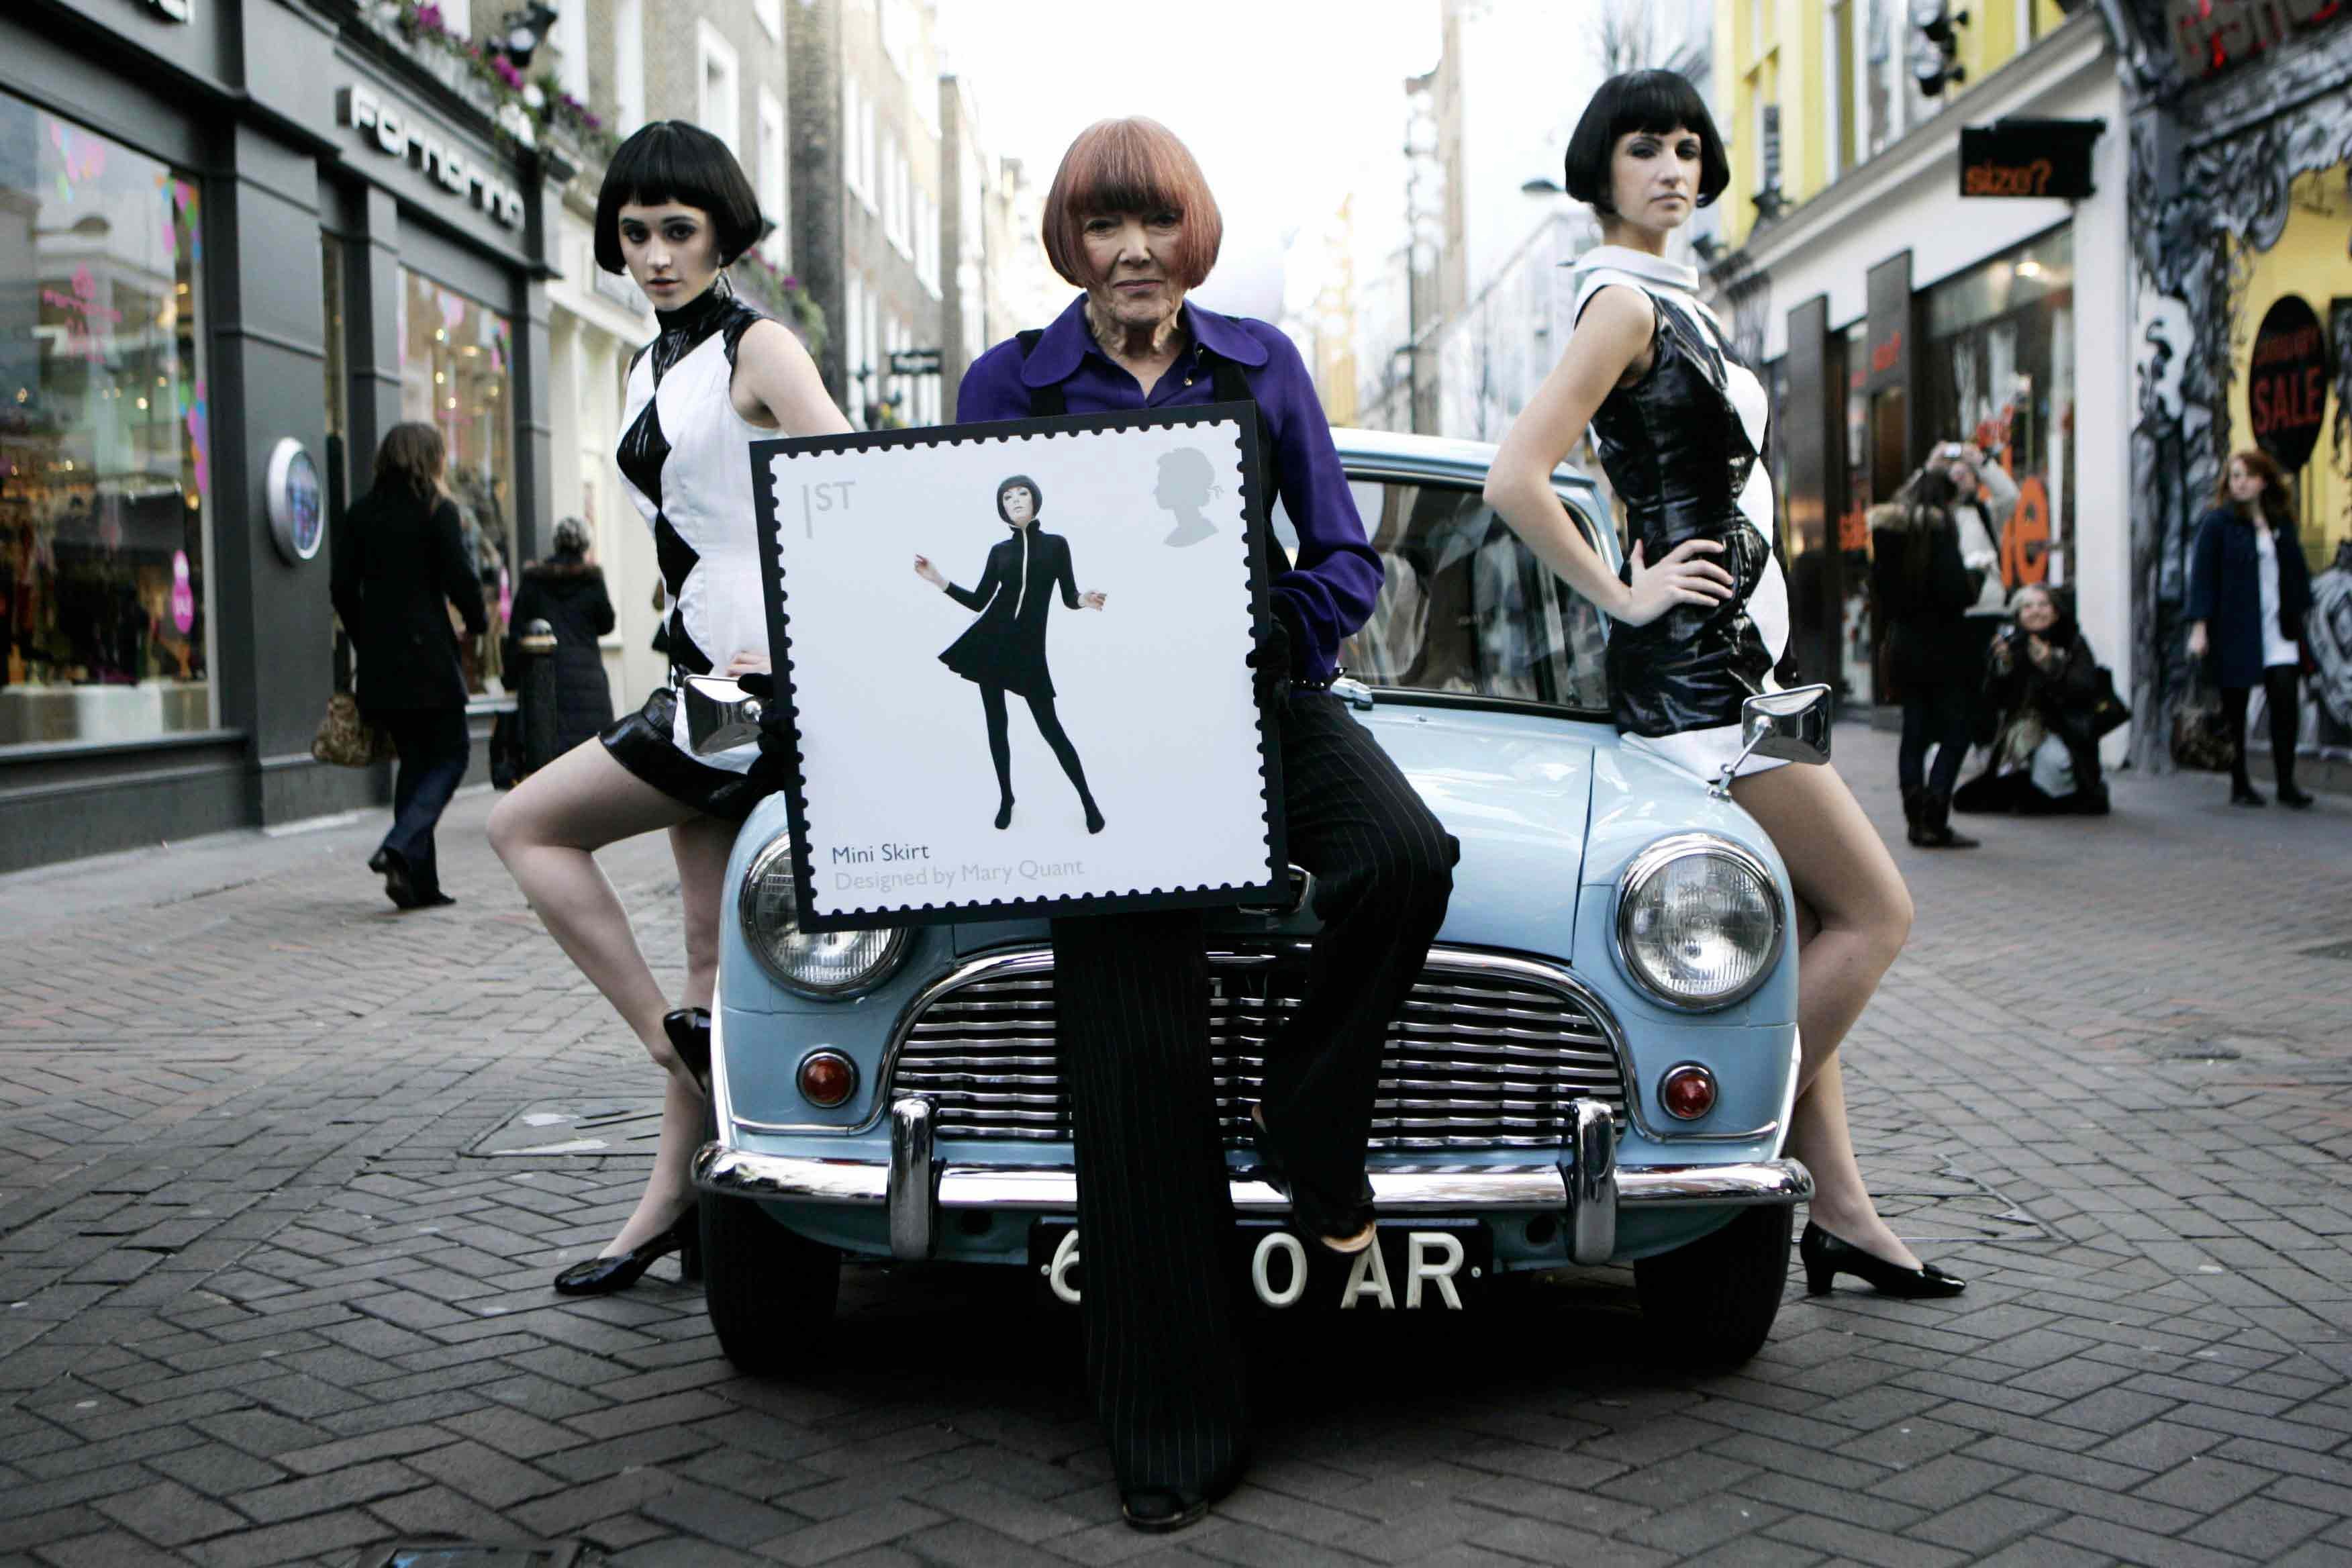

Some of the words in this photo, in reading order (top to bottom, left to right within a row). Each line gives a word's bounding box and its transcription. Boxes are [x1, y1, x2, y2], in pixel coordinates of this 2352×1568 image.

[2254, 365, 2321, 434] SALE
[801, 480, 856, 540] 1ST
[832, 845, 875, 865] Mini
[881, 842, 930, 862] Skirt
[834, 867, 928, 893] Designed
[932, 866, 957, 890] by
[961, 864, 1013, 885] Mary
[1018, 859, 1085, 881] Quant
[1340, 1232, 1463, 1310] AR
